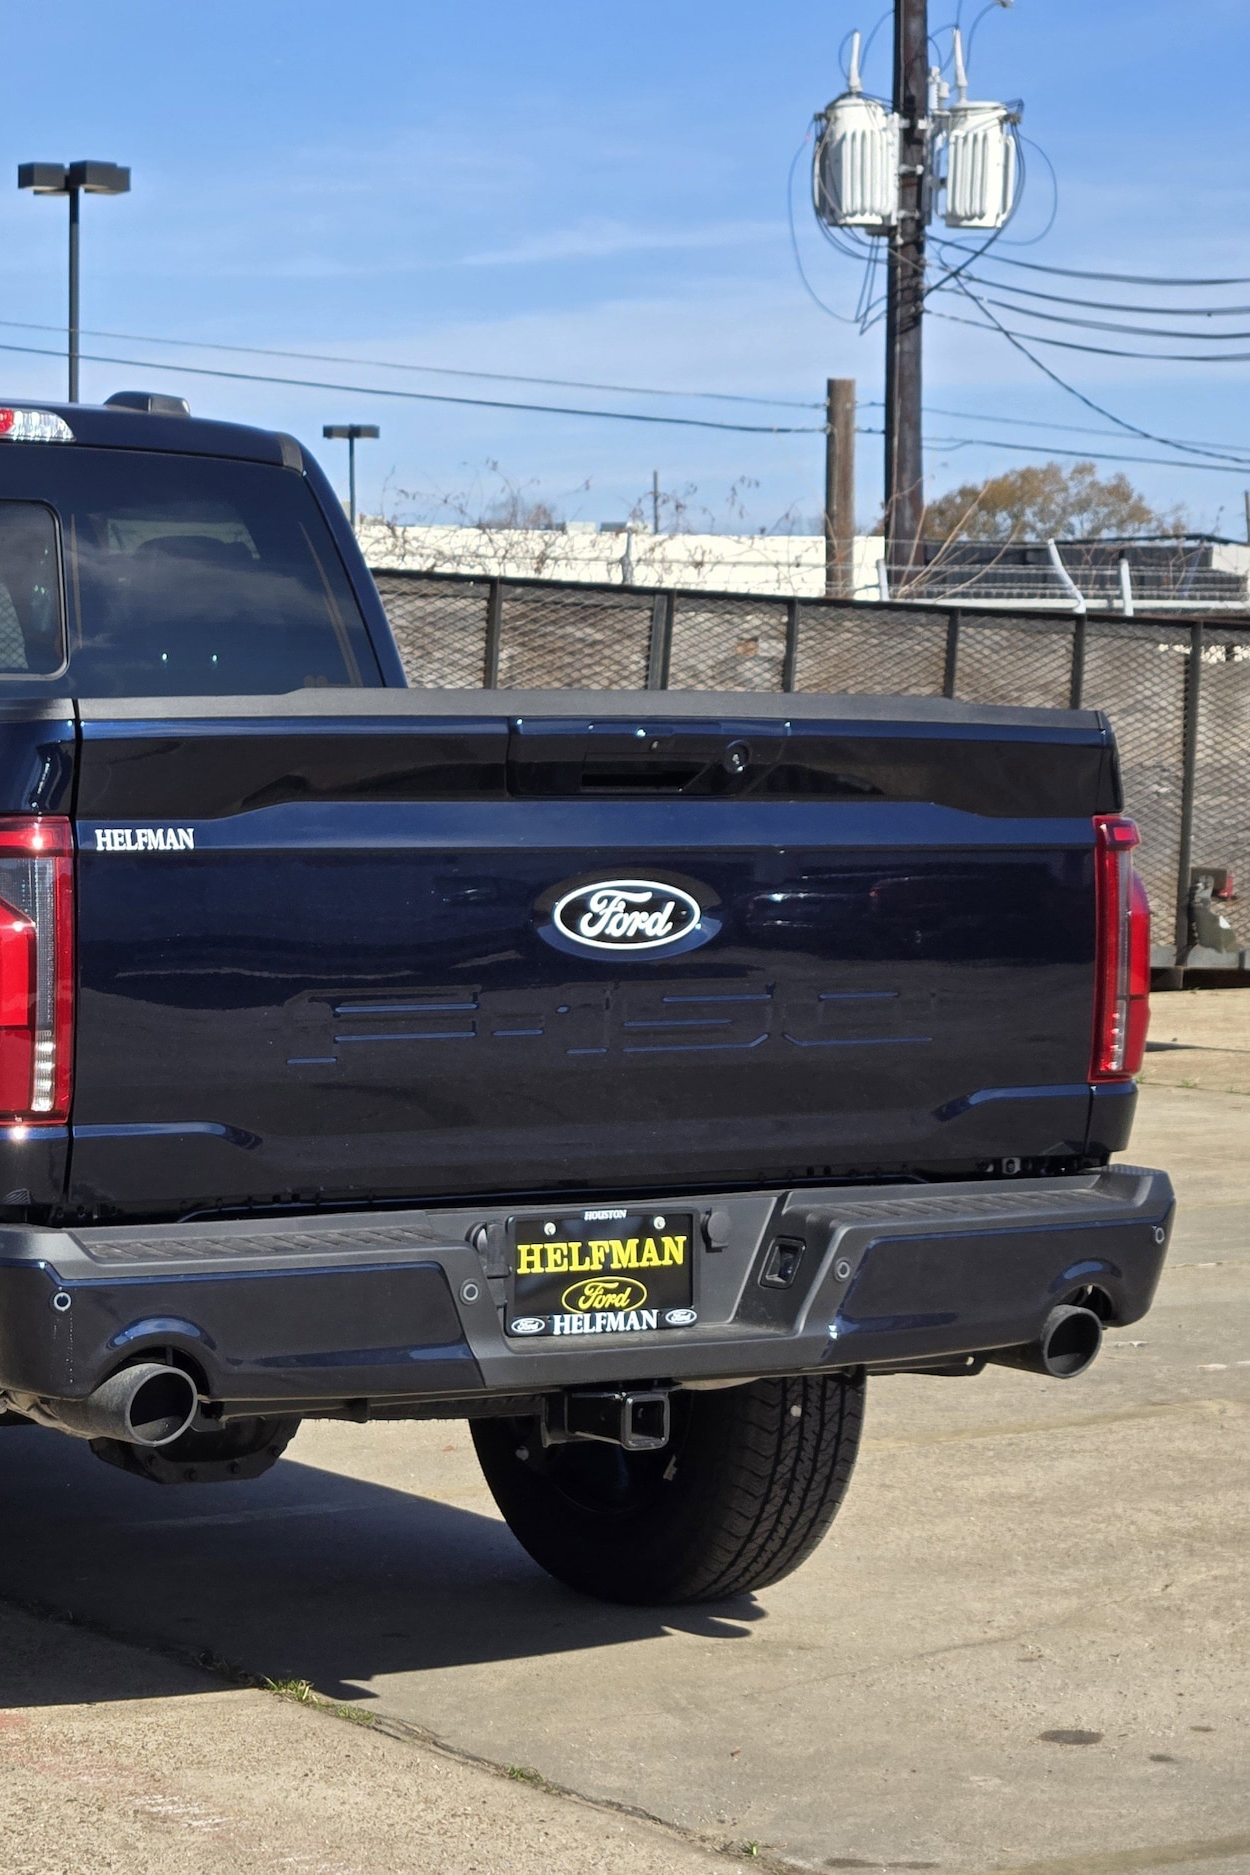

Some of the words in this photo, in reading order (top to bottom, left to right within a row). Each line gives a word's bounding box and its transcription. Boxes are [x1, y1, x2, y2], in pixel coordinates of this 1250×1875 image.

[94, 828, 195, 851] HELFMAN
[579, 889, 674, 938] Ford
[583, 1209, 628, 1221] HOUSTON
[516, 1235, 688, 1275] HELFMAN
[577, 1281, 632, 1310] Ford
[552, 1309, 661, 1336] HELFMAN
